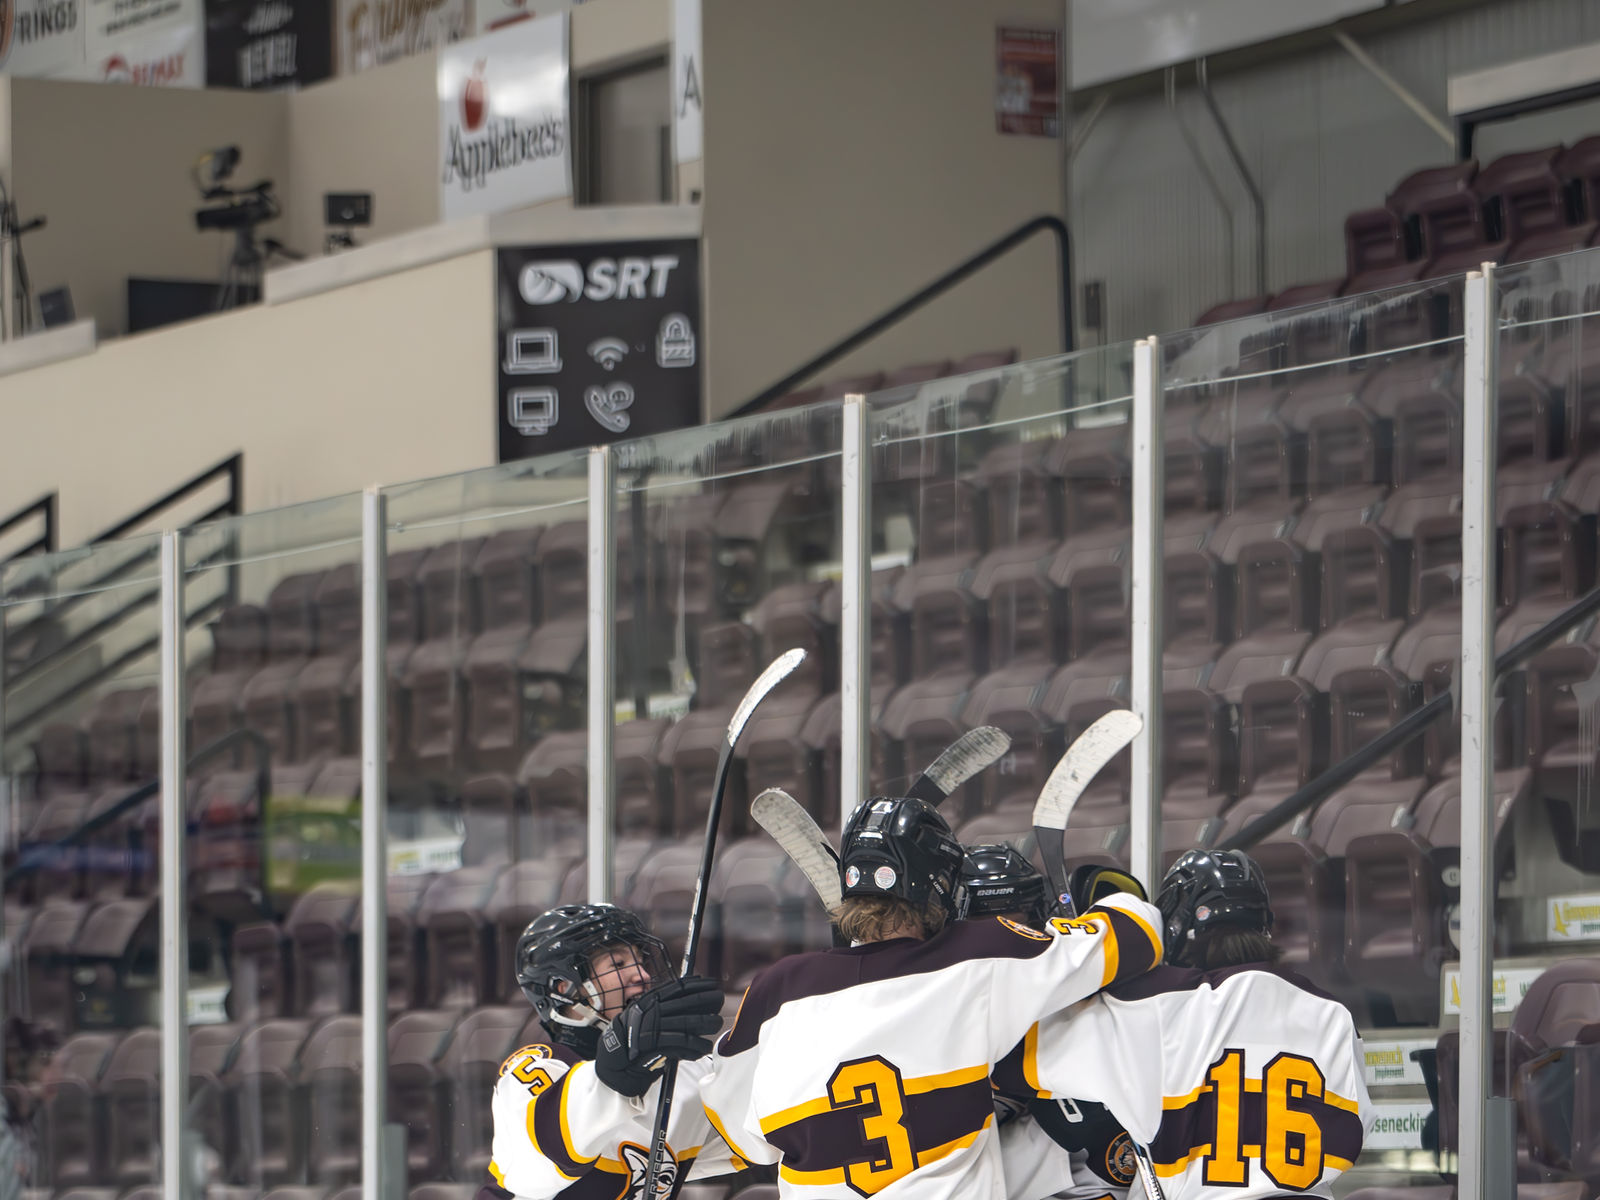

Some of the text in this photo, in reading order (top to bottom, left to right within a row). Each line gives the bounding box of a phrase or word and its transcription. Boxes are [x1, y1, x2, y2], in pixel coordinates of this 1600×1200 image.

[442, 113, 565, 191] Applebee's
[584, 256, 680, 301] SRT
[976, 887, 1014, 897] BAUER
[511, 1056, 554, 1097] 5
[826, 1054, 919, 1199] 3
[1202, 1048, 1326, 1191] 16
